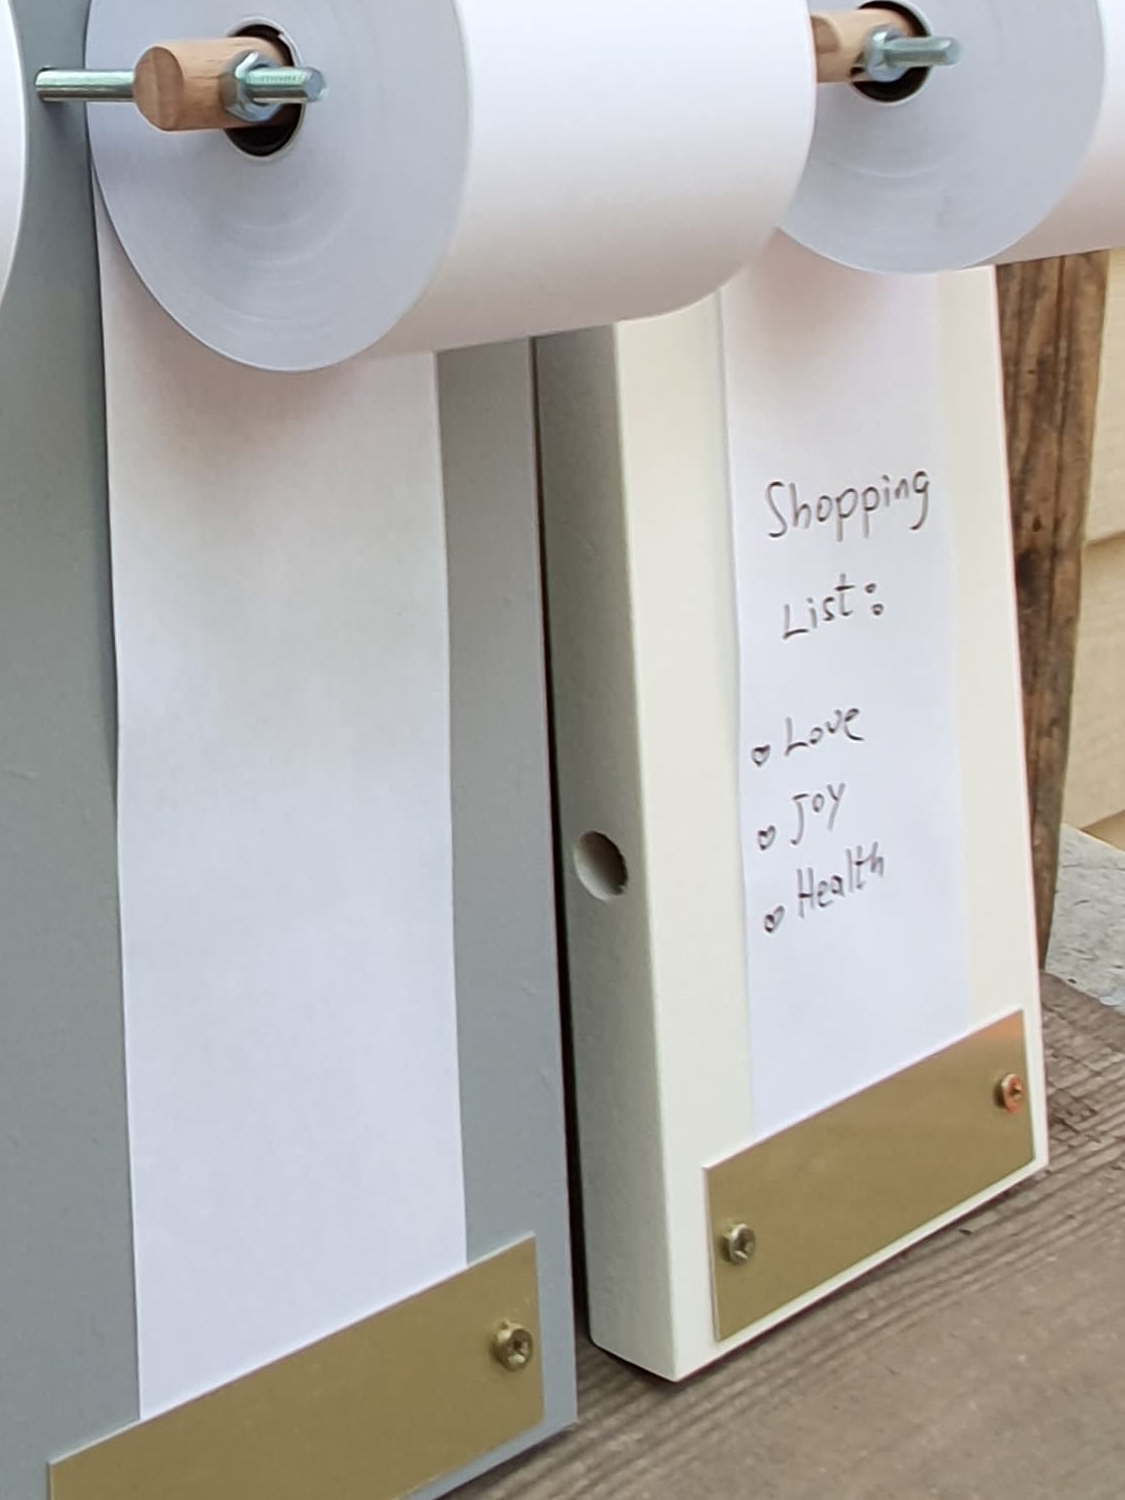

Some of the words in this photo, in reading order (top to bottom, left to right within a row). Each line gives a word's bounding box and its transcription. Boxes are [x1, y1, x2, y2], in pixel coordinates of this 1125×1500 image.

[766, 470, 931, 543] Shopping
[782, 572, 885, 640] List:
[783, 706, 865, 757] Love
[789, 782, 847, 846] Joy
[795, 841, 886, 919] Health
